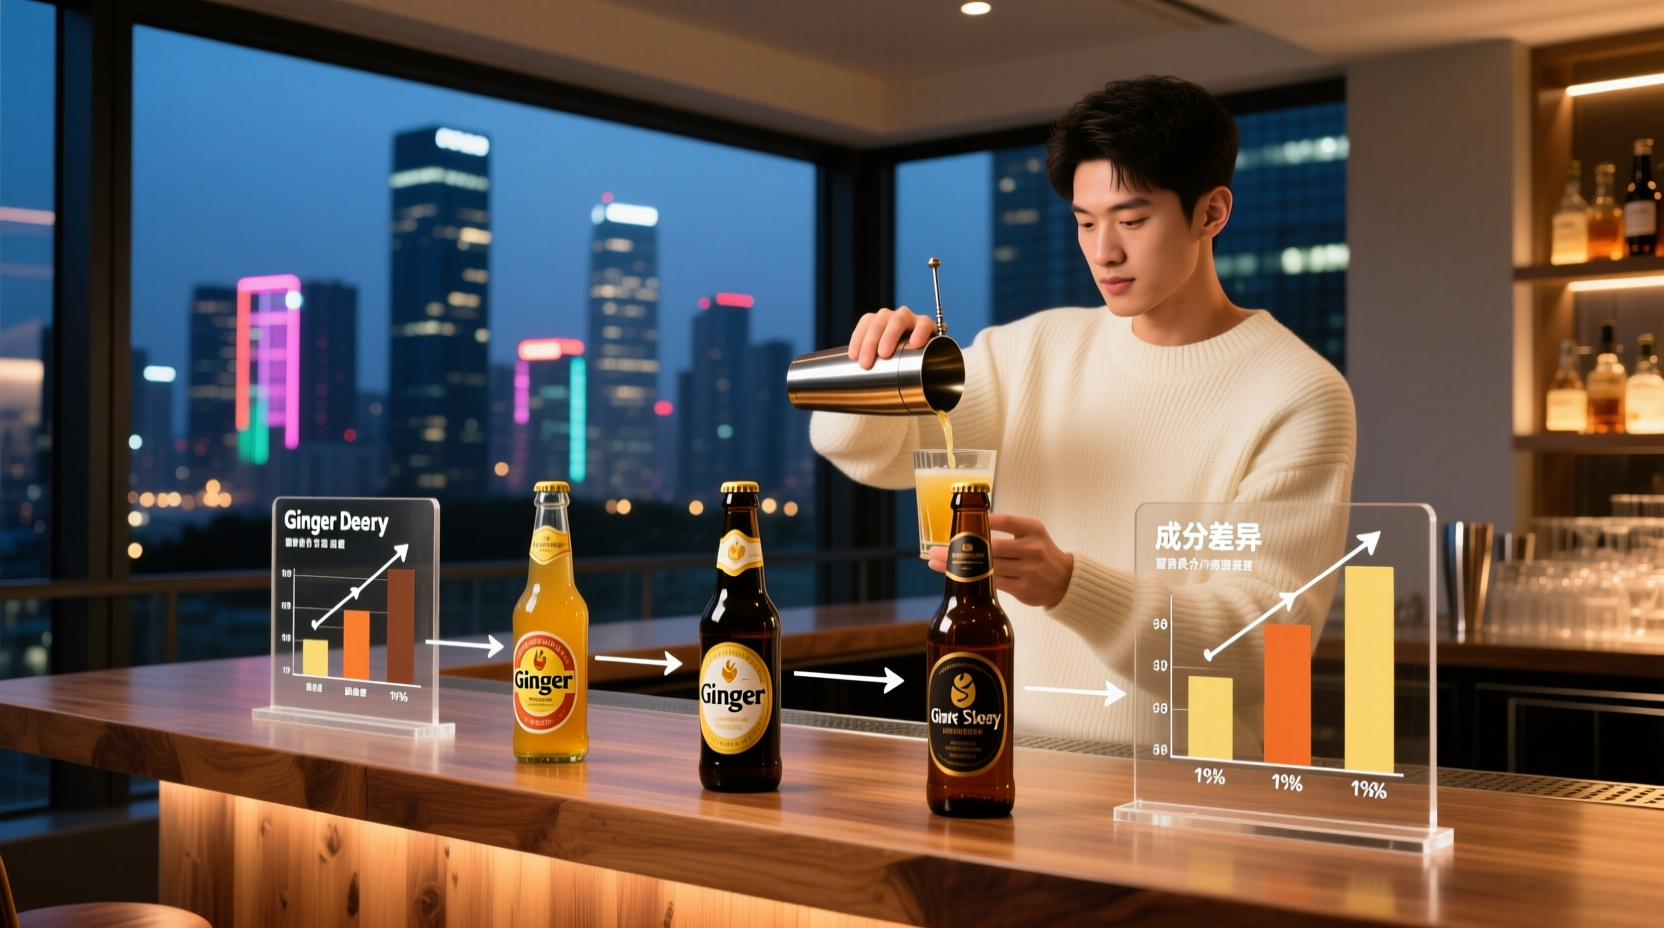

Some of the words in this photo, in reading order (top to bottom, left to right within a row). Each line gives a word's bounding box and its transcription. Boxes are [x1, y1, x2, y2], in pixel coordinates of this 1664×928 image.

[284, 509, 337, 536] Ginger
[340, 510, 389, 538] Deery
[1155, 521, 1262, 552] 成分差异
[515, 670, 573, 696] Ginger
[701, 683, 766, 713] Ginger
